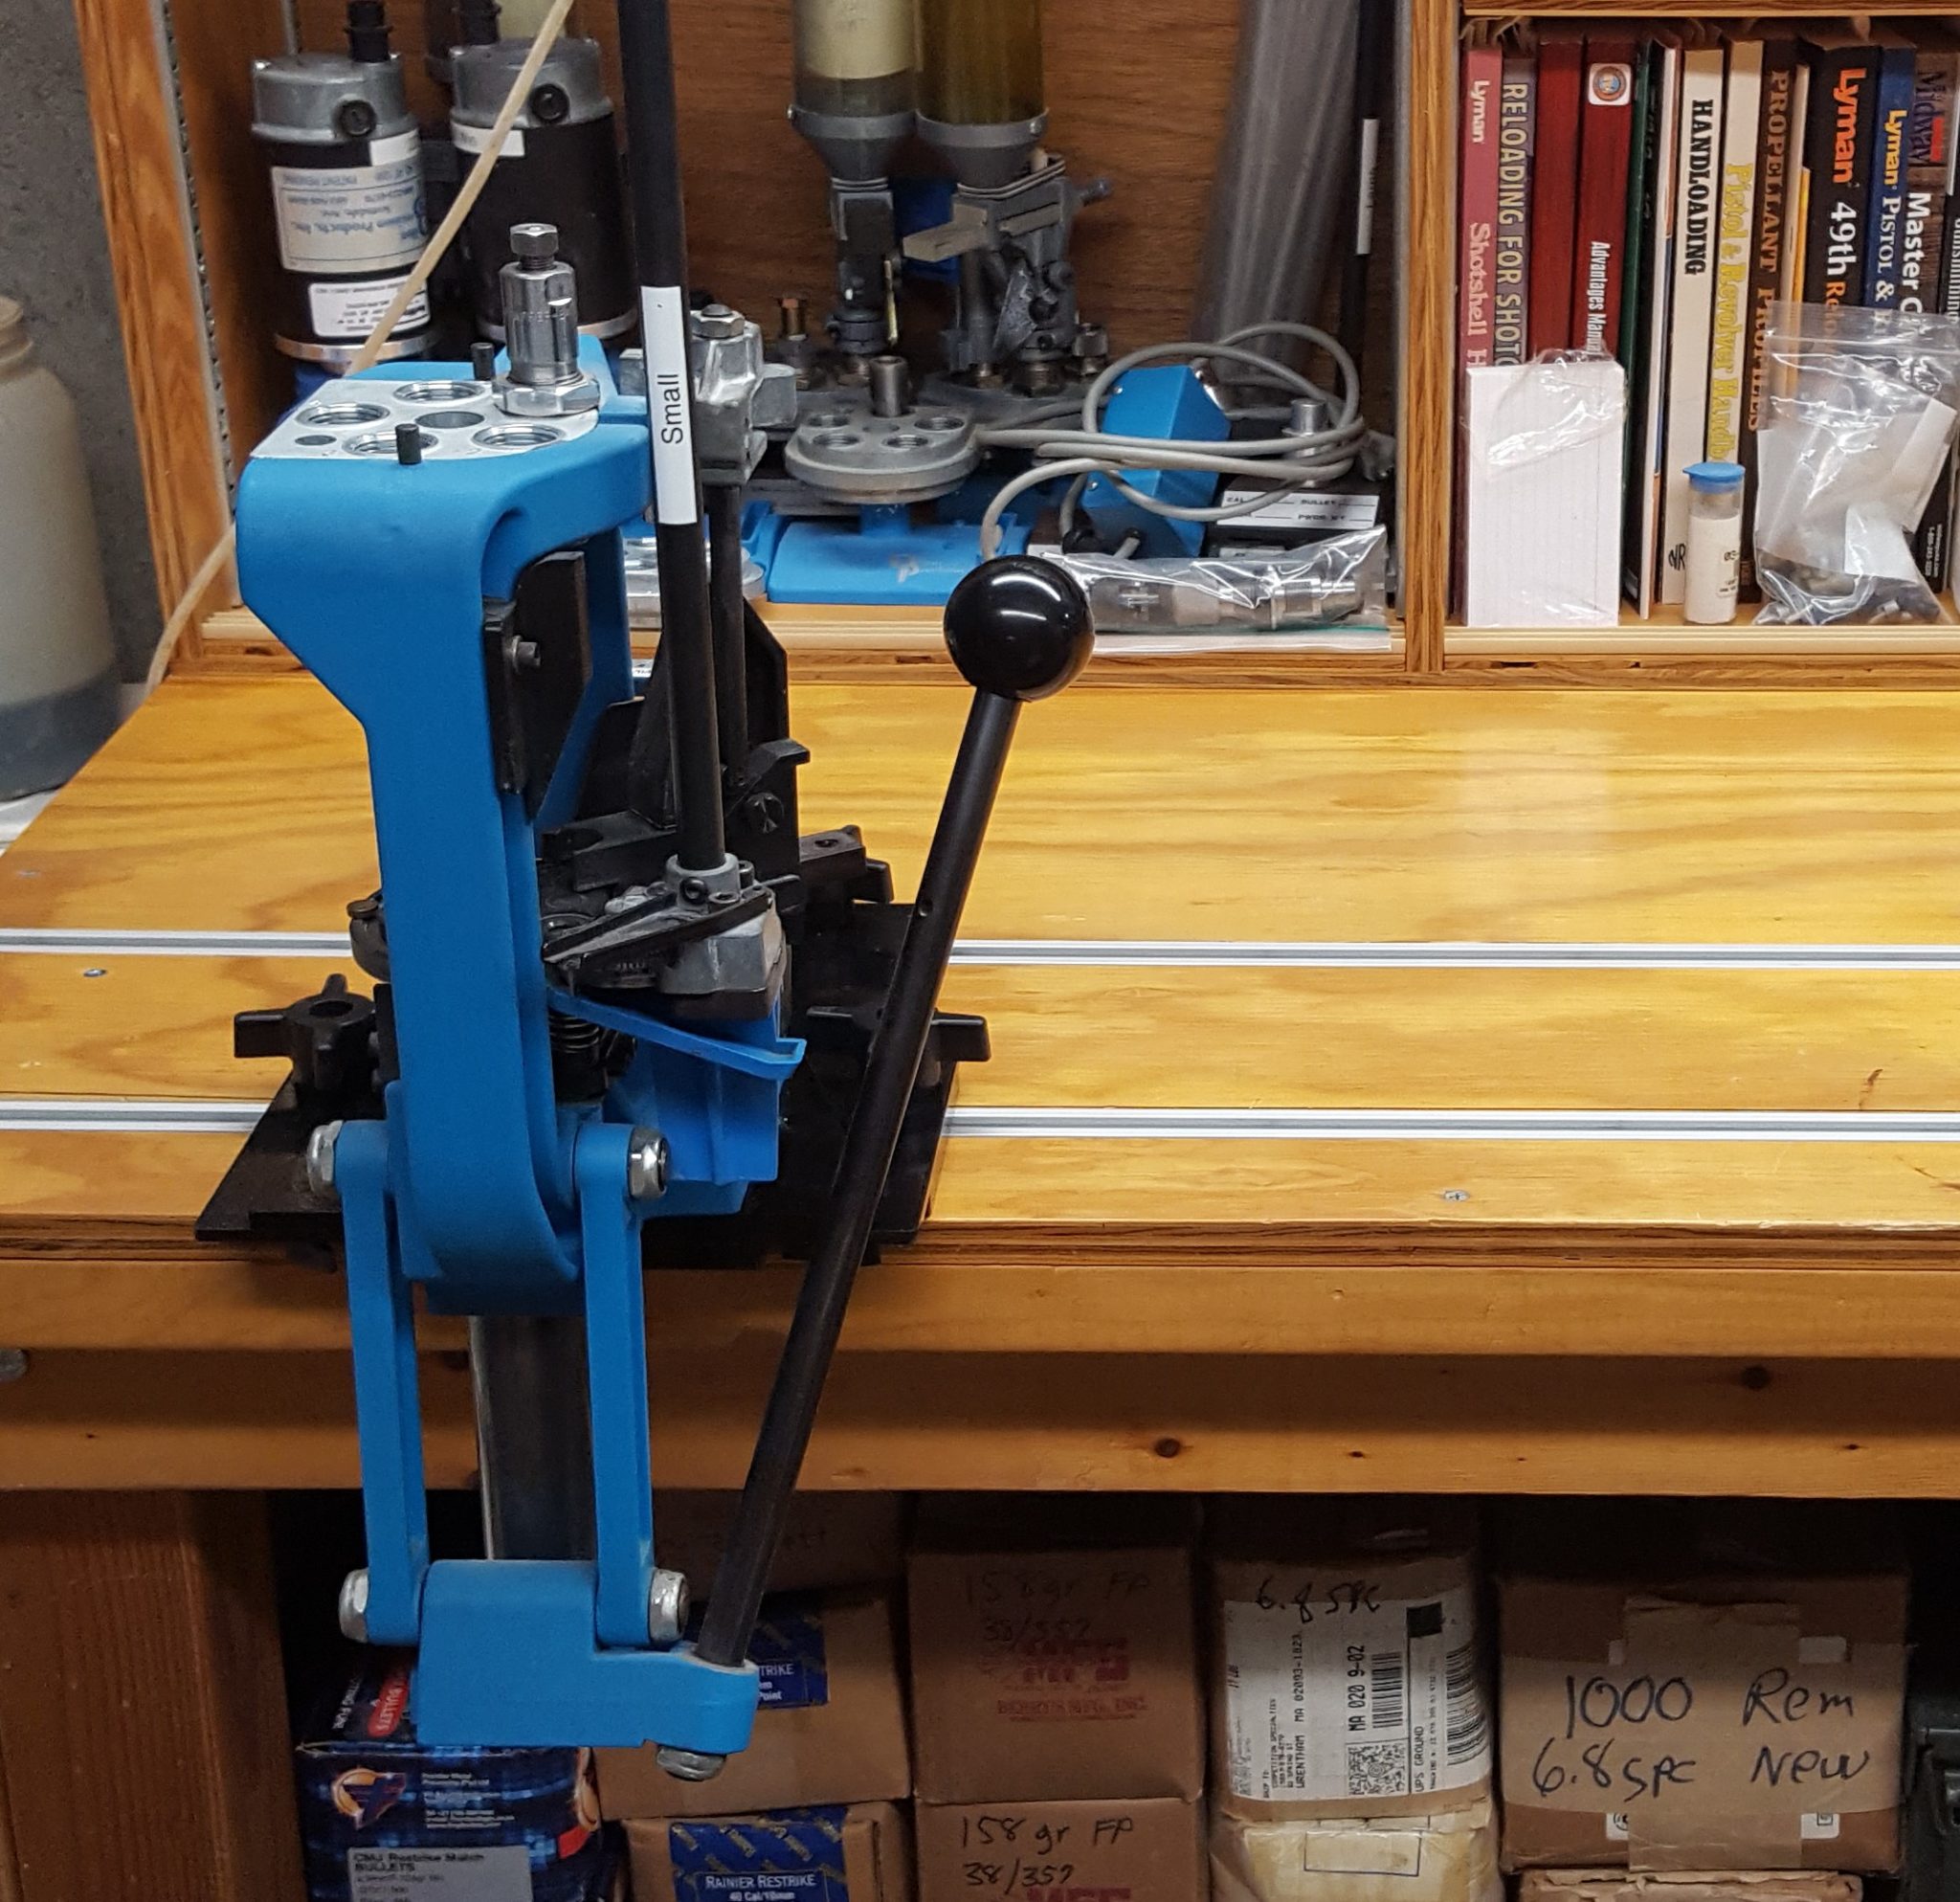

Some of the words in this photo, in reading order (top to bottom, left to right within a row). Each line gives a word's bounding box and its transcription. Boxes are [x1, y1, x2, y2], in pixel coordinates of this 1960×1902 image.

[1472, 79, 1490, 145] Lyman
[1833, 68, 1866, 185] Lyman
[1882, 108, 1906, 186] Lyman
[1910, 71, 1947, 167] Midway
[1500, 82, 1527, 227] RELOADING
[1684, 98, 1713, 277] HANDLOADING
[1761, 69, 1789, 274] PROPELLANT
[1723, 162, 1753, 243] Pistol
[1880, 196, 1901, 275] PISTOL
[1903, 192, 1931, 280] Master
[1498, 235, 1525, 284] FOR
[1827, 201, 1858, 277] 49th
[1467, 221, 1491, 338] Shotshell
[1586, 241, 1611, 314] Advantages
[1874, 280, 1895, 302] &
[1901, 297, 1922, 314] C
[1714, 262, 1746, 380] Revolver
[657, 373, 683, 444] Small
[1708, 379, 1739, 460] Handb
[758, 1664, 795, 1676] TRIKE
[1347, 1645, 1364, 1677] 9-02
[1348, 1684, 1364, 1708] 020
[1294, 1709, 1304, 1722] MA
[1348, 1715, 1366, 1732] MA
[1565, 1674, 1694, 1739] 1000
[1743, 1667, 1855, 1727] Rem
[1295, 1735, 1305, 1788] WRENTHAM
[1414, 1726, 1424, 1766] GROUND
[1411, 1772, 1424, 1792] UPS
[963, 1816, 1026, 1848] 158
[1035, 1824, 1070, 1855] gr
[1093, 1816, 1134, 1846] FP
[704, 1875, 756, 1890] RAINIER
[757, 1873, 817, 1889] RESTRIKE
